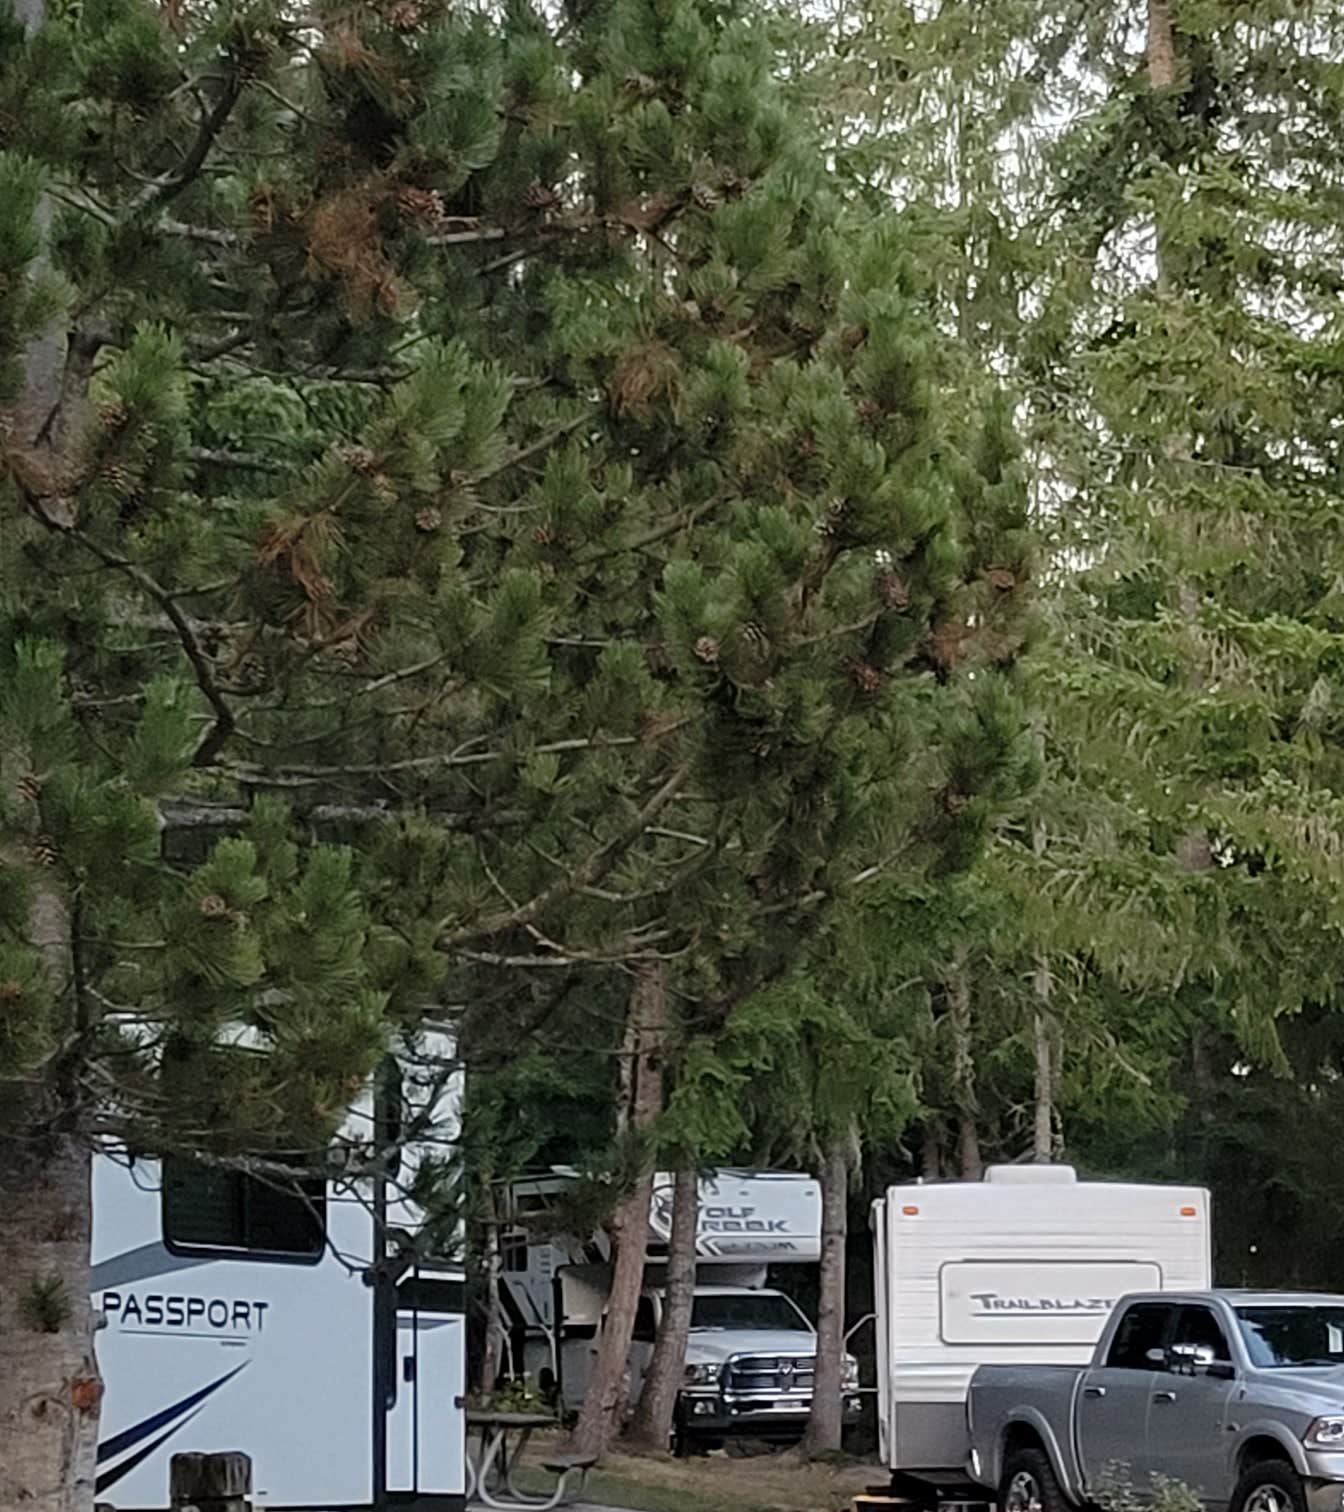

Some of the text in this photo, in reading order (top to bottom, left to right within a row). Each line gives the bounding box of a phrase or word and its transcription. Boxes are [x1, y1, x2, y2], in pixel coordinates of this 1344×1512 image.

[698, 1206, 756, 1218] OLF
[701, 1220, 792, 1232] REEK
[102, 1292, 269, 1332] PASSPORT
